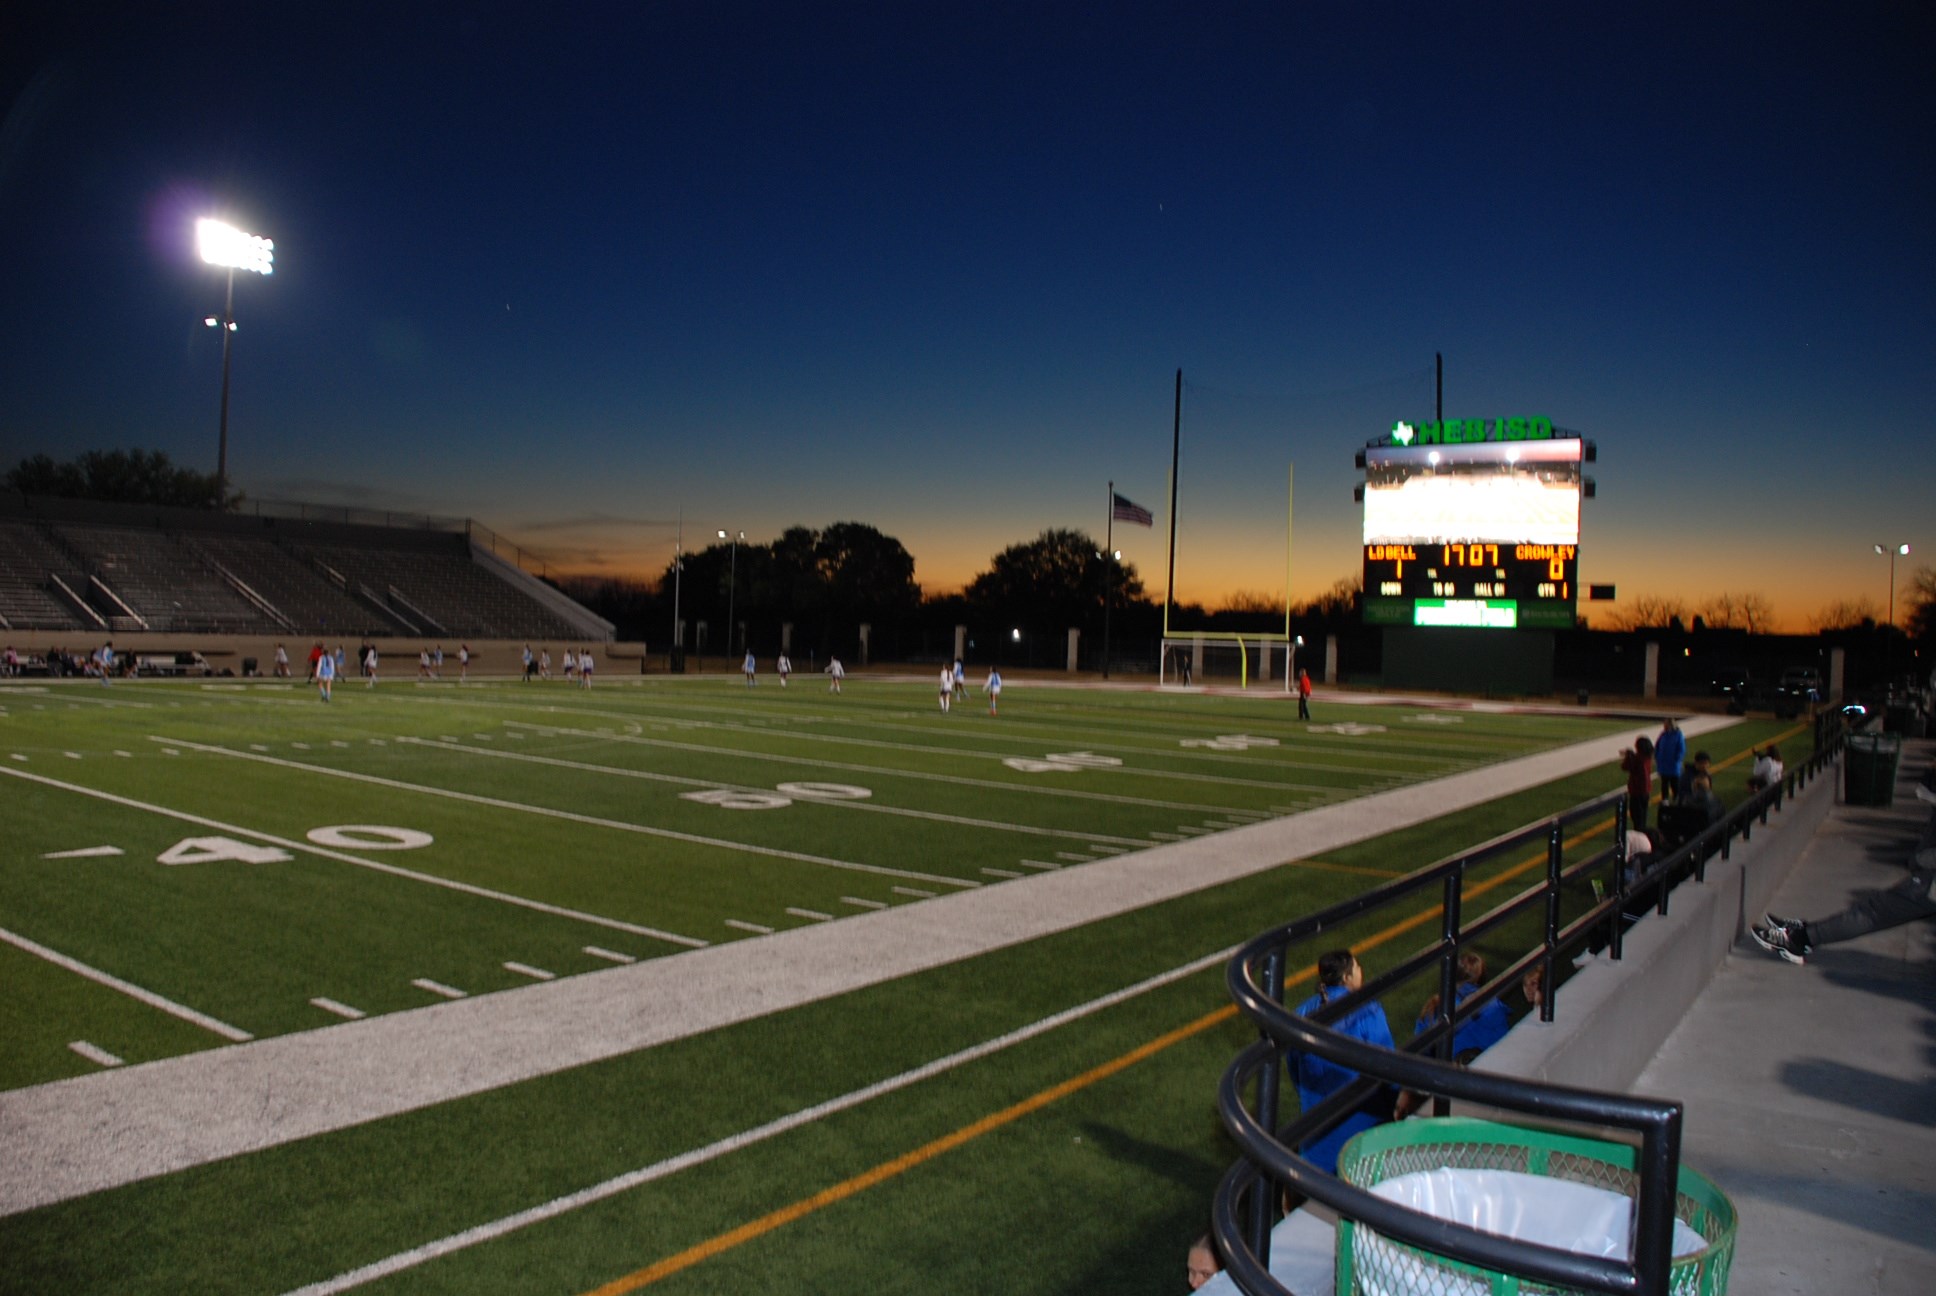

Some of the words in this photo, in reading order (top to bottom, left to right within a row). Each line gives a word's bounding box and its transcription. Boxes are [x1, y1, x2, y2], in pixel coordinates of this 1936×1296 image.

[1418, 418, 1486, 444] HEB
[1495, 415, 1553, 441] ISD
[1516, 544, 1575, 560] CROWLEY
[156, 824, 434, 865] 40
